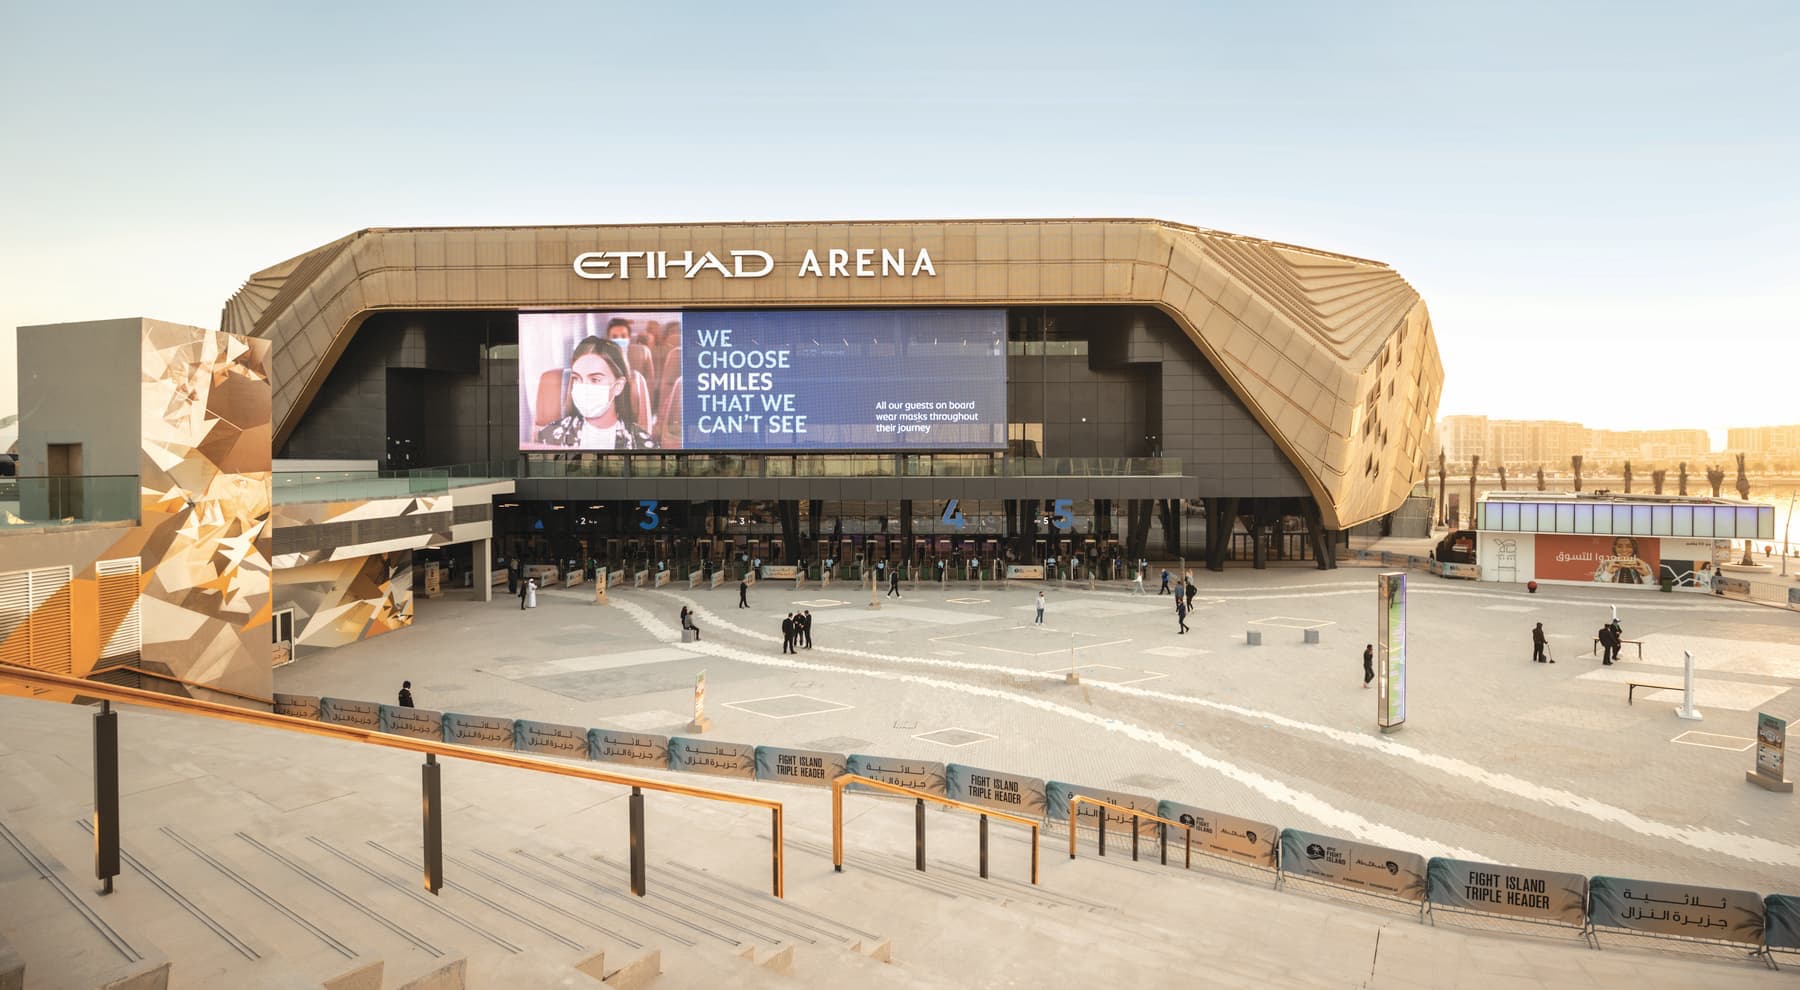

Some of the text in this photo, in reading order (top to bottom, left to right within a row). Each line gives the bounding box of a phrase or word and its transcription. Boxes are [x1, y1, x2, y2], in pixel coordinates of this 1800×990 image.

[573, 248, 937, 280] ETIHAD ARENA
[697, 329, 732, 347] WE
[698, 350, 790, 368] CHOOSE
[697, 372, 773, 391] SMILES
[698, 394, 795, 412] THAT WE
[875, 401, 887, 410] All
[905, 402, 934, 412] guests
[949, 401, 975, 410] board
[698, 415, 807, 433] CAN'T SEE
[899, 412, 928, 421] masks
[929, 412, 978, 423] throughout
[875, 423, 930, 435] their journey
[580, 517, 586, 525] 2
[639, 500, 660, 530] 3
[739, 517, 745, 525] 3
[942, 499, 965, 529] 4
[1043, 517, 1049, 525] 5
[1052, 499, 1073, 529] 5
[778, 753, 823, 768] FIGHT ISLAND
[776, 764, 825, 779] TRIPLE HEADER
[971, 774, 1018, 792] FIGHT ISLAND
[969, 785, 1021, 805] TRIPLE HEADER
[1326, 856, 1346, 866] ISLAND
[1469, 871, 1545, 893] FIGHT ISLAND
[1464, 885, 1550, 910] TRIPLE HEADER
[1623, 888, 1726, 909] ثلاثية
[1621, 906, 1728, 930] جزيرة النزال
